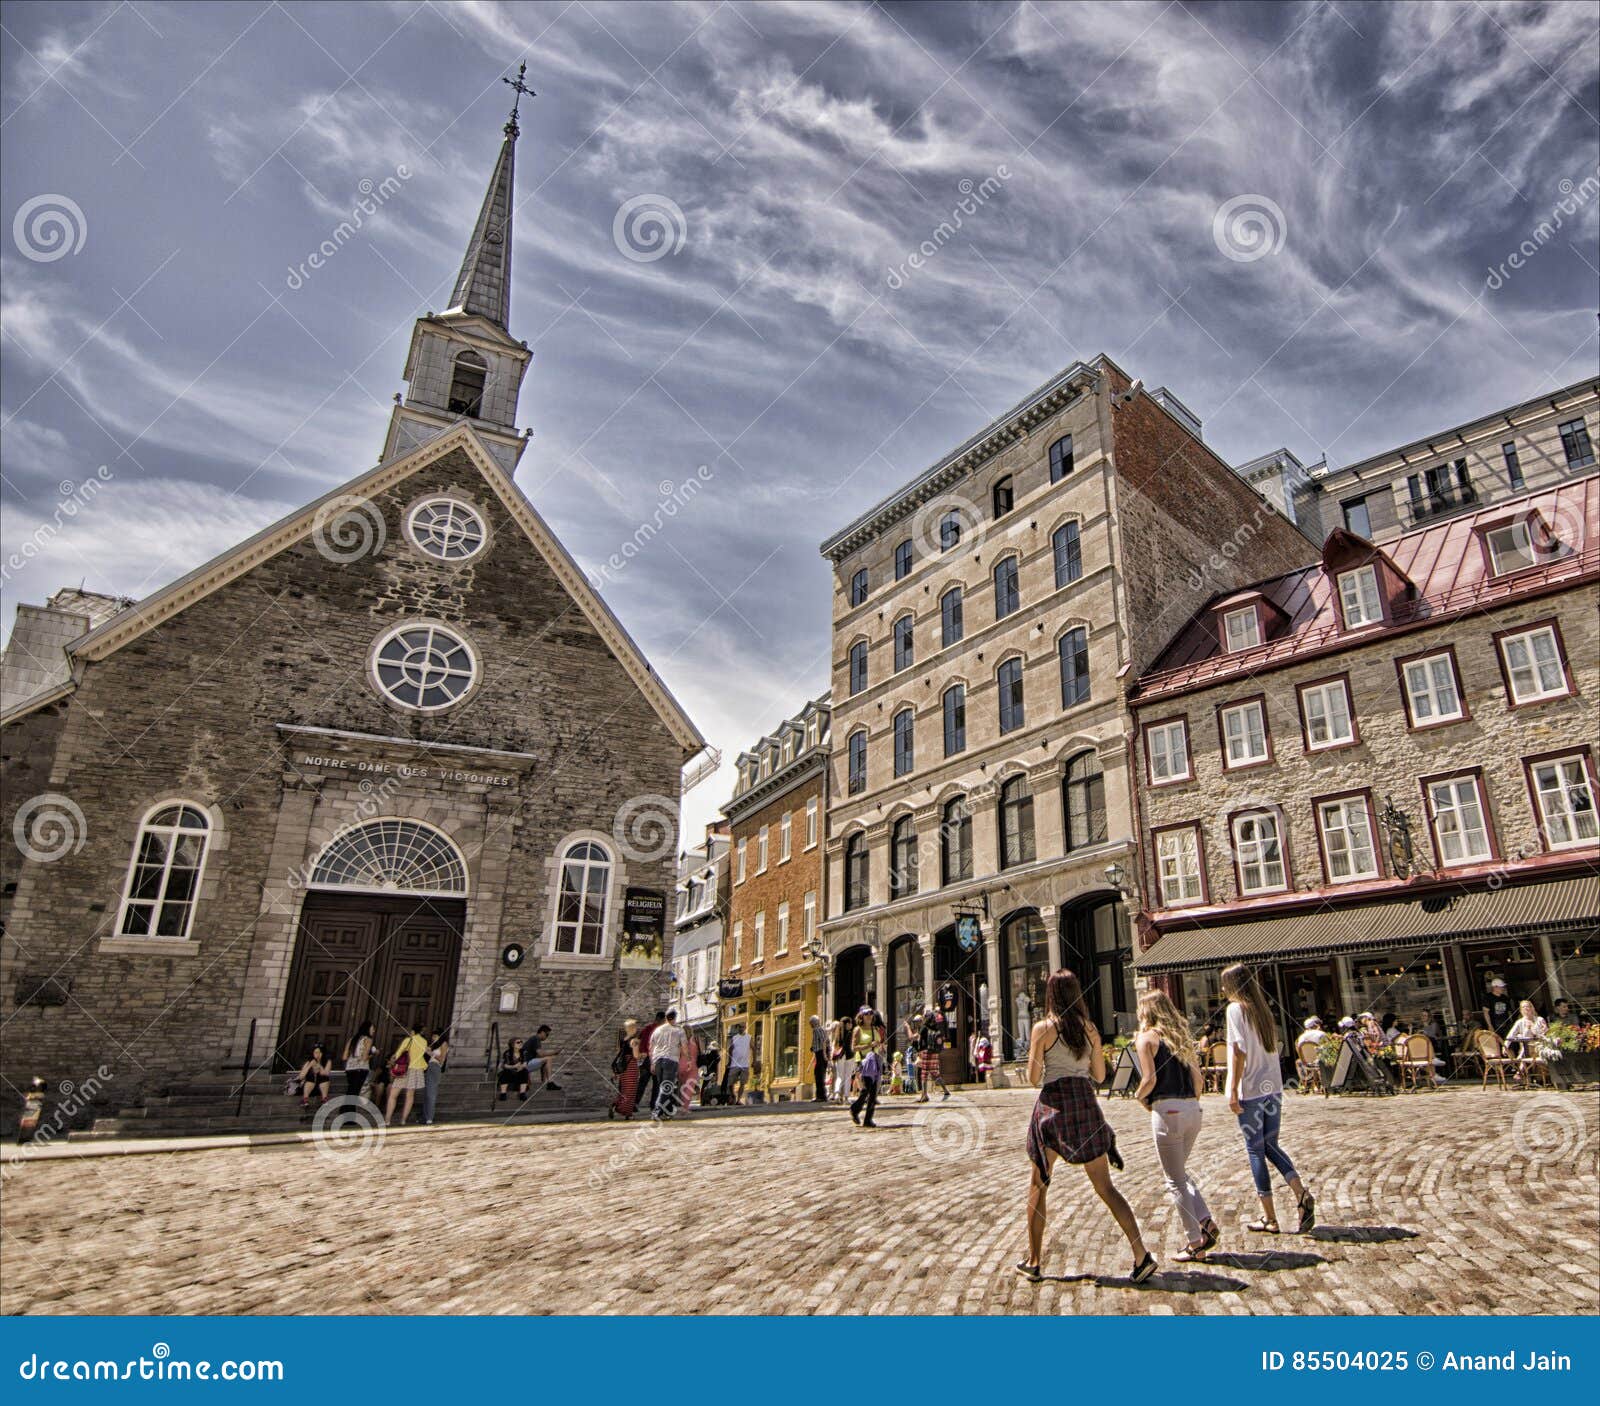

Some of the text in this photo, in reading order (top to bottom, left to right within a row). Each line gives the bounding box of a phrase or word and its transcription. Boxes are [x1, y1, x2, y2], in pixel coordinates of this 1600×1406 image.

[403, 765, 428, 778] DES
[440, 770, 509, 787] VICTOIRES
[627, 899, 663, 909] RELIGIEUX
